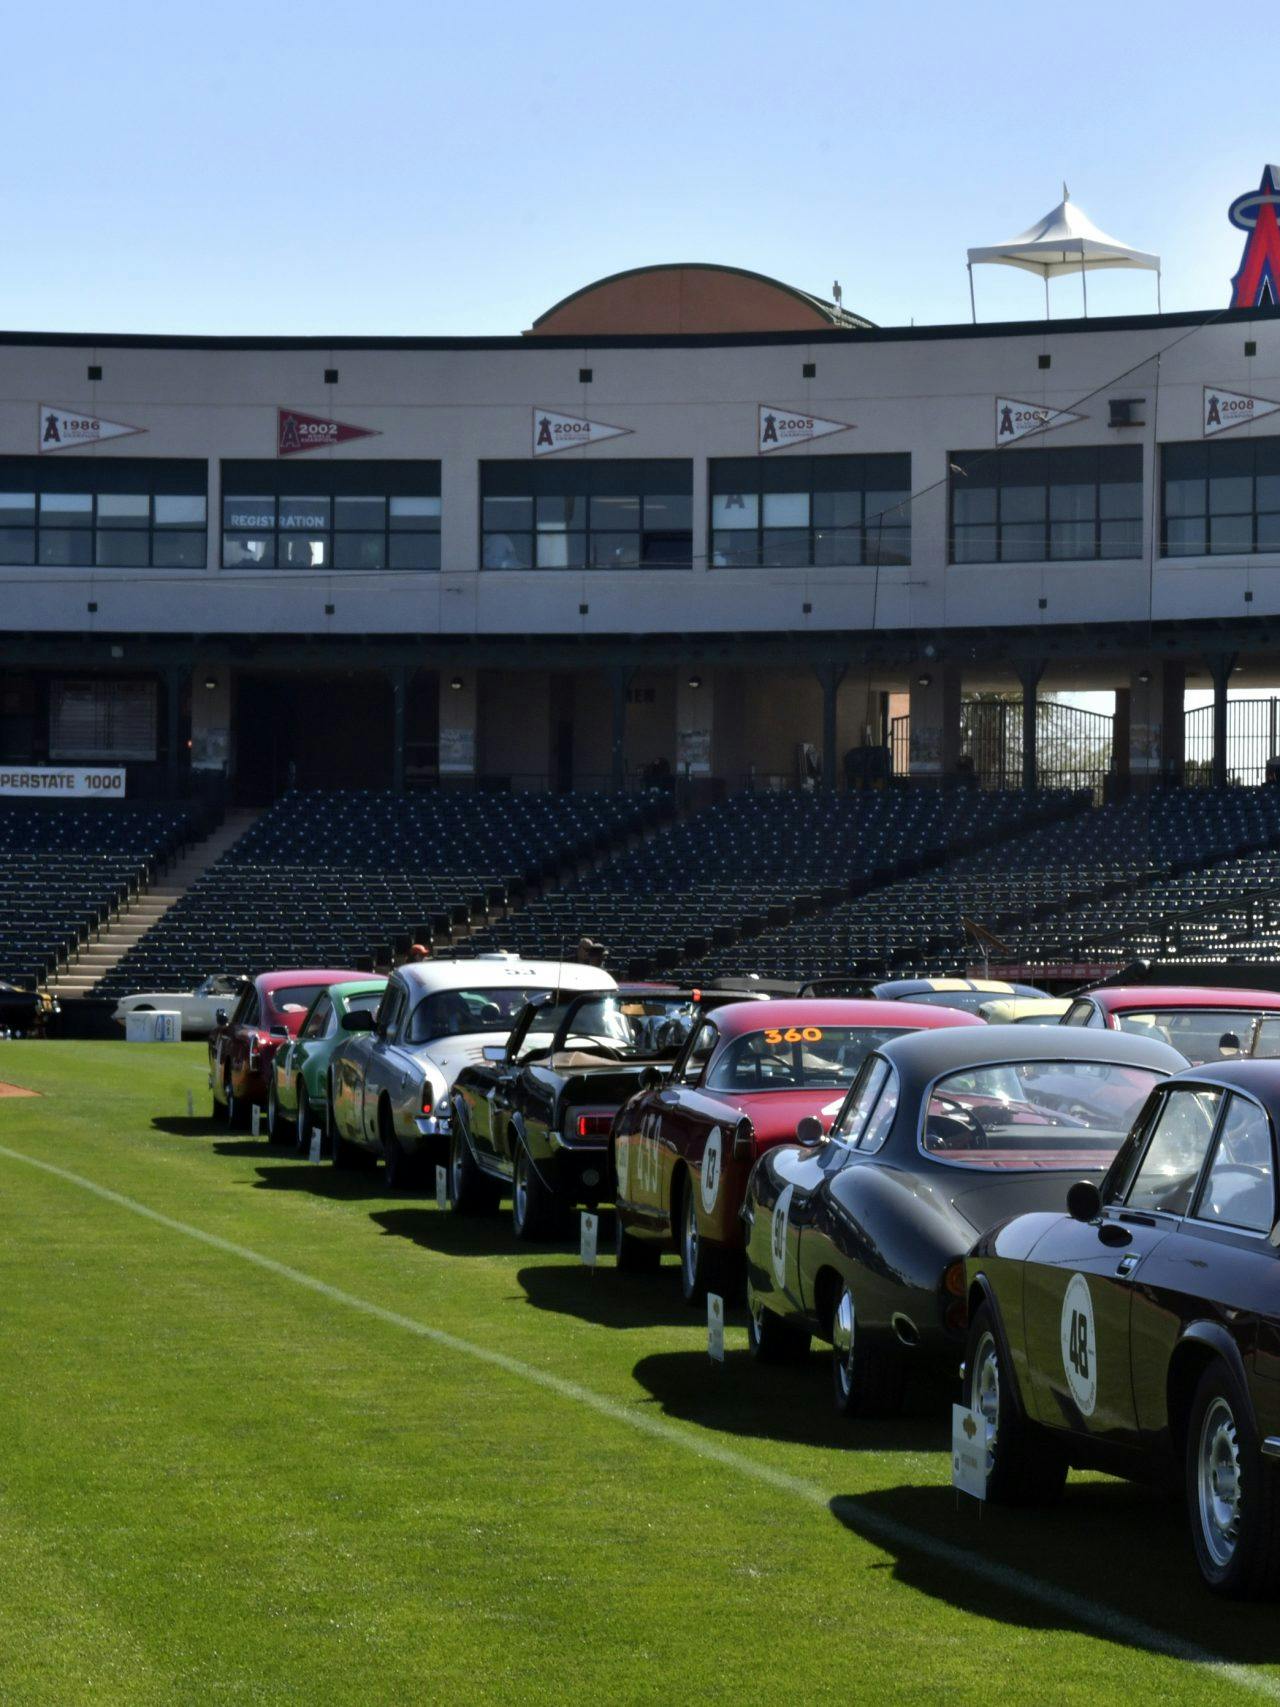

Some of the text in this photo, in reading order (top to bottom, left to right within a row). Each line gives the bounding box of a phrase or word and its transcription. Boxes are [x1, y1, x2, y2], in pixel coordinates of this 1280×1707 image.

[1222, 400, 1254, 410] 2008
[63, 420, 100, 431] 1986
[300, 424, 338, 434] 2002
[554, 423, 591, 433] 2004
[779, 420, 814, 429] 2005
[231, 514, 325, 527] REGISTRATION
[0, 774, 121, 788] PERSTATE 1000
[764, 1027, 822, 1044] 360
[706, 1147, 716, 1189] 13
[1069, 1310, 1089, 1379] 48
